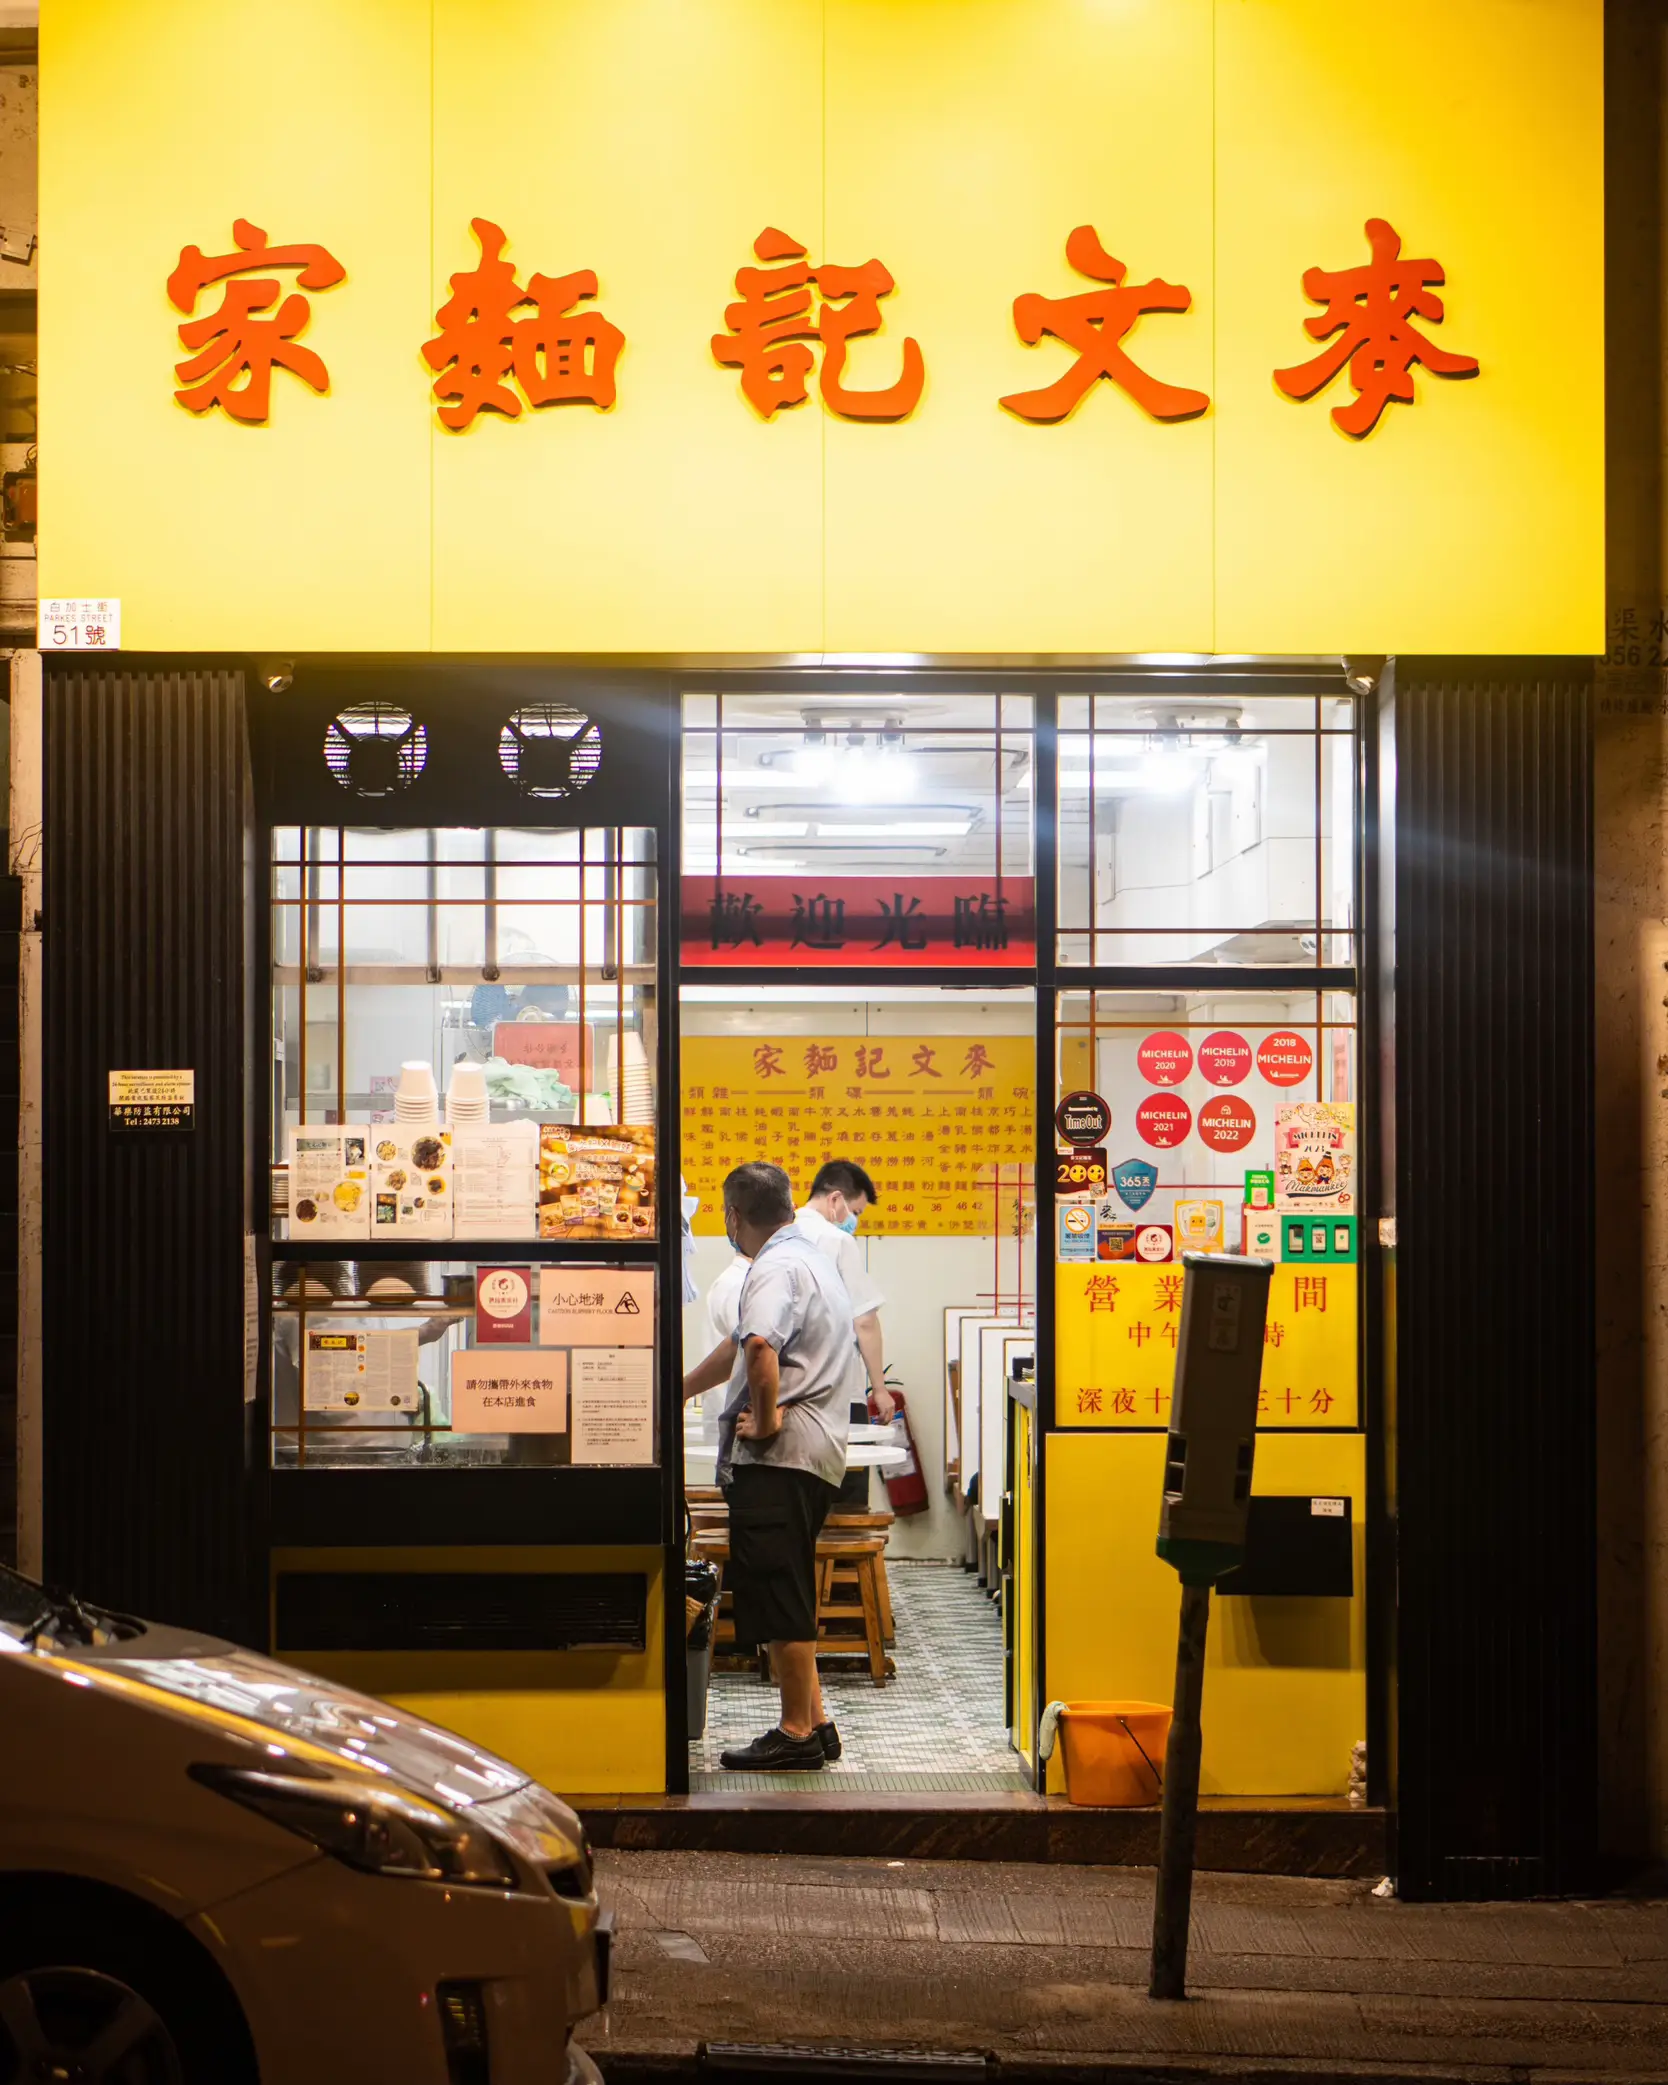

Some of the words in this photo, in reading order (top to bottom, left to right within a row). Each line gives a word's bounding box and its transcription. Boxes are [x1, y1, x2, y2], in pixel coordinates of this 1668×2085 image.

[44, 614, 76, 623] PARKES
[80, 614, 113, 623] STREET
[53, 625, 106, 645] 51號
[707, 893, 1009, 951] 歡迎光臨
[1273, 1038, 1296, 1047] 2018
[1141, 1050, 1188, 1059] MICHELIN
[1201, 1047, 1249, 1057] MICHELIN
[1213, 1058, 1236, 1067] 2019
[1257, 1054, 1312, 1064] MICHELIN
[1154, 1061, 1176, 1070] 2020
[1140, 1111, 1188, 1120] MICHELIN
[124, 1118, 137, 1126] Tel
[143, 1118, 160, 1126] 2473
[162, 1118, 179, 1126] 2138
[1064, 1113, 1085, 1130] Time
[1086, 1113, 1102, 1130] Out
[1153, 1122, 1174, 1131] 2021
[1202, 1118, 1252, 1128] MICHELIN
[1213, 1130, 1239, 1140] 2022
[1083, 1274, 1328, 1313] 營業間
[553, 1293, 605, 1306] 小心地滑
[466, 1379, 553, 1391] 請勿攜帶外來食物
[483, 1395, 536, 1408] 在本店進食
